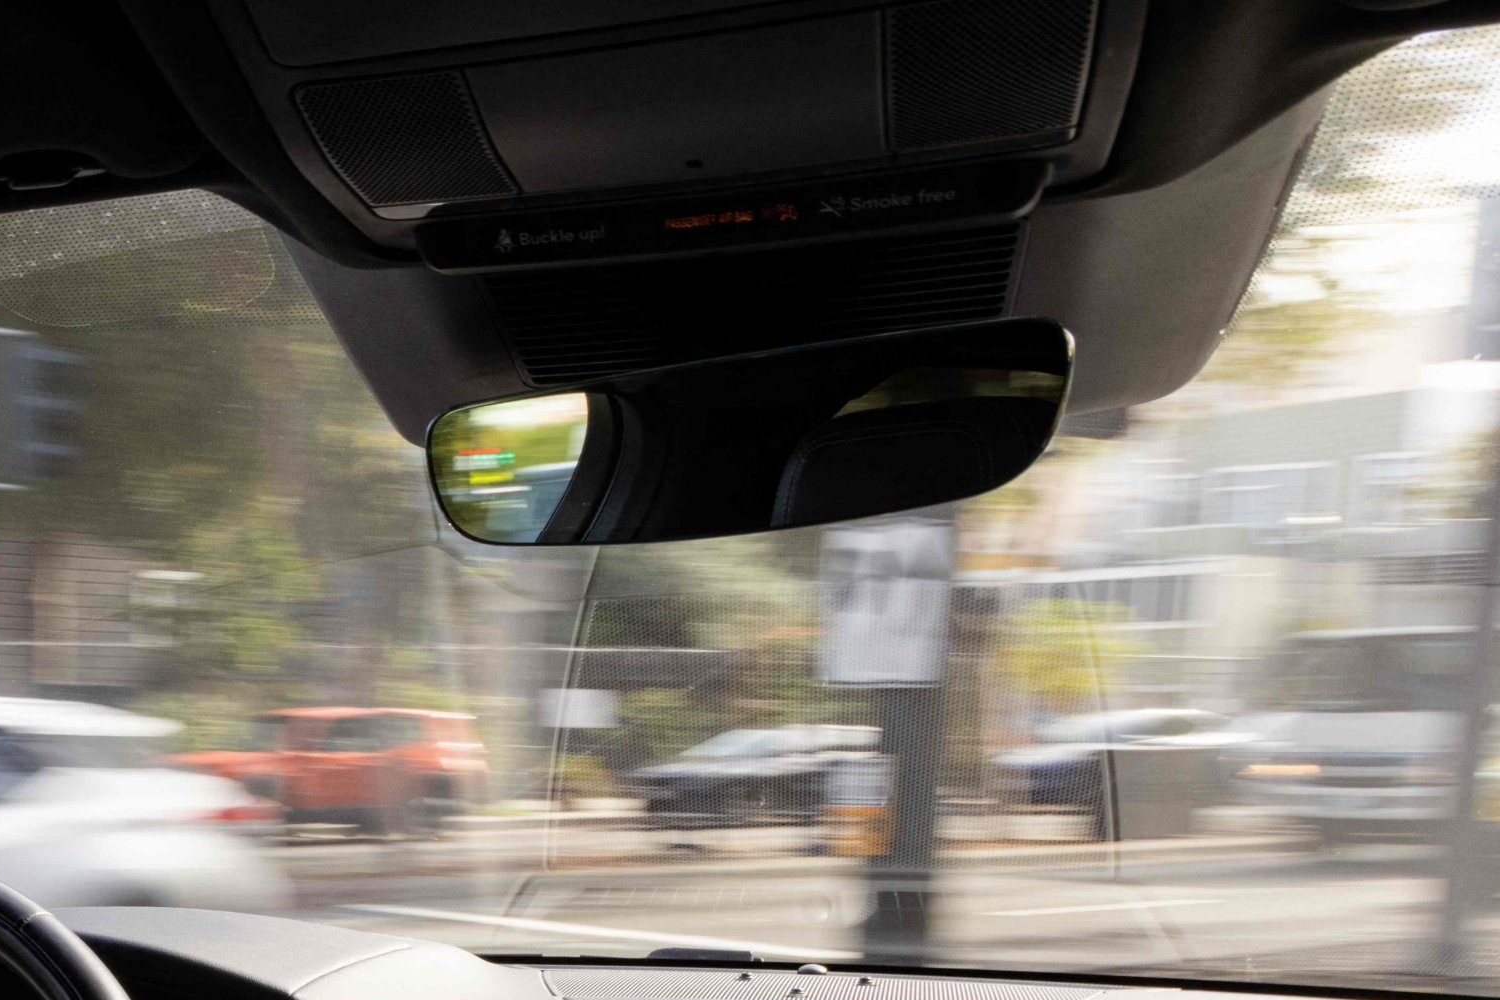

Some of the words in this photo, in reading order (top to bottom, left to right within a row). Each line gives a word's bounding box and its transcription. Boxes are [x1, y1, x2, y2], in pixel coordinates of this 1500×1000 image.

[850, 192, 912, 211] Smoke
[917, 188, 956, 203] free
[519, 229, 574, 246] Buckle
[579, 223, 606, 243] up!
